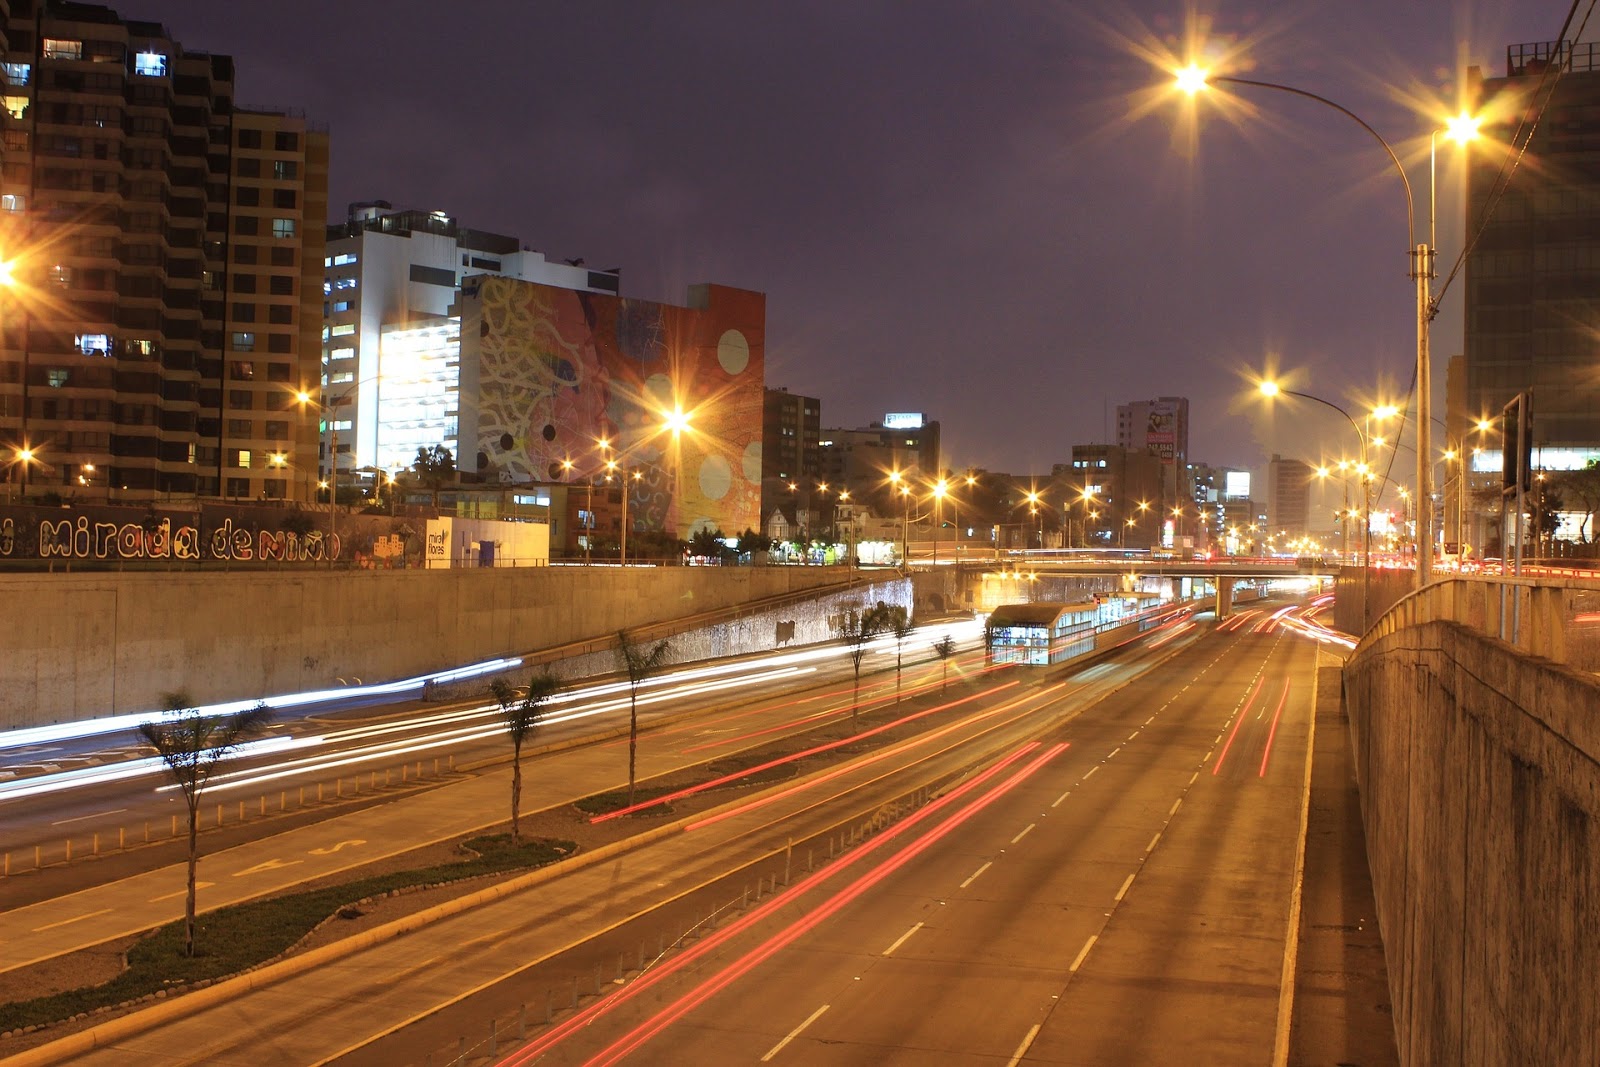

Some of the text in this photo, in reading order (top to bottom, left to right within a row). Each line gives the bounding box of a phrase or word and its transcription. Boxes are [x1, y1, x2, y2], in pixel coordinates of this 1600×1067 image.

[39, 516, 200, 558] Mirada
[211, 518, 252, 560] de
[427, 544, 445, 555] flores
